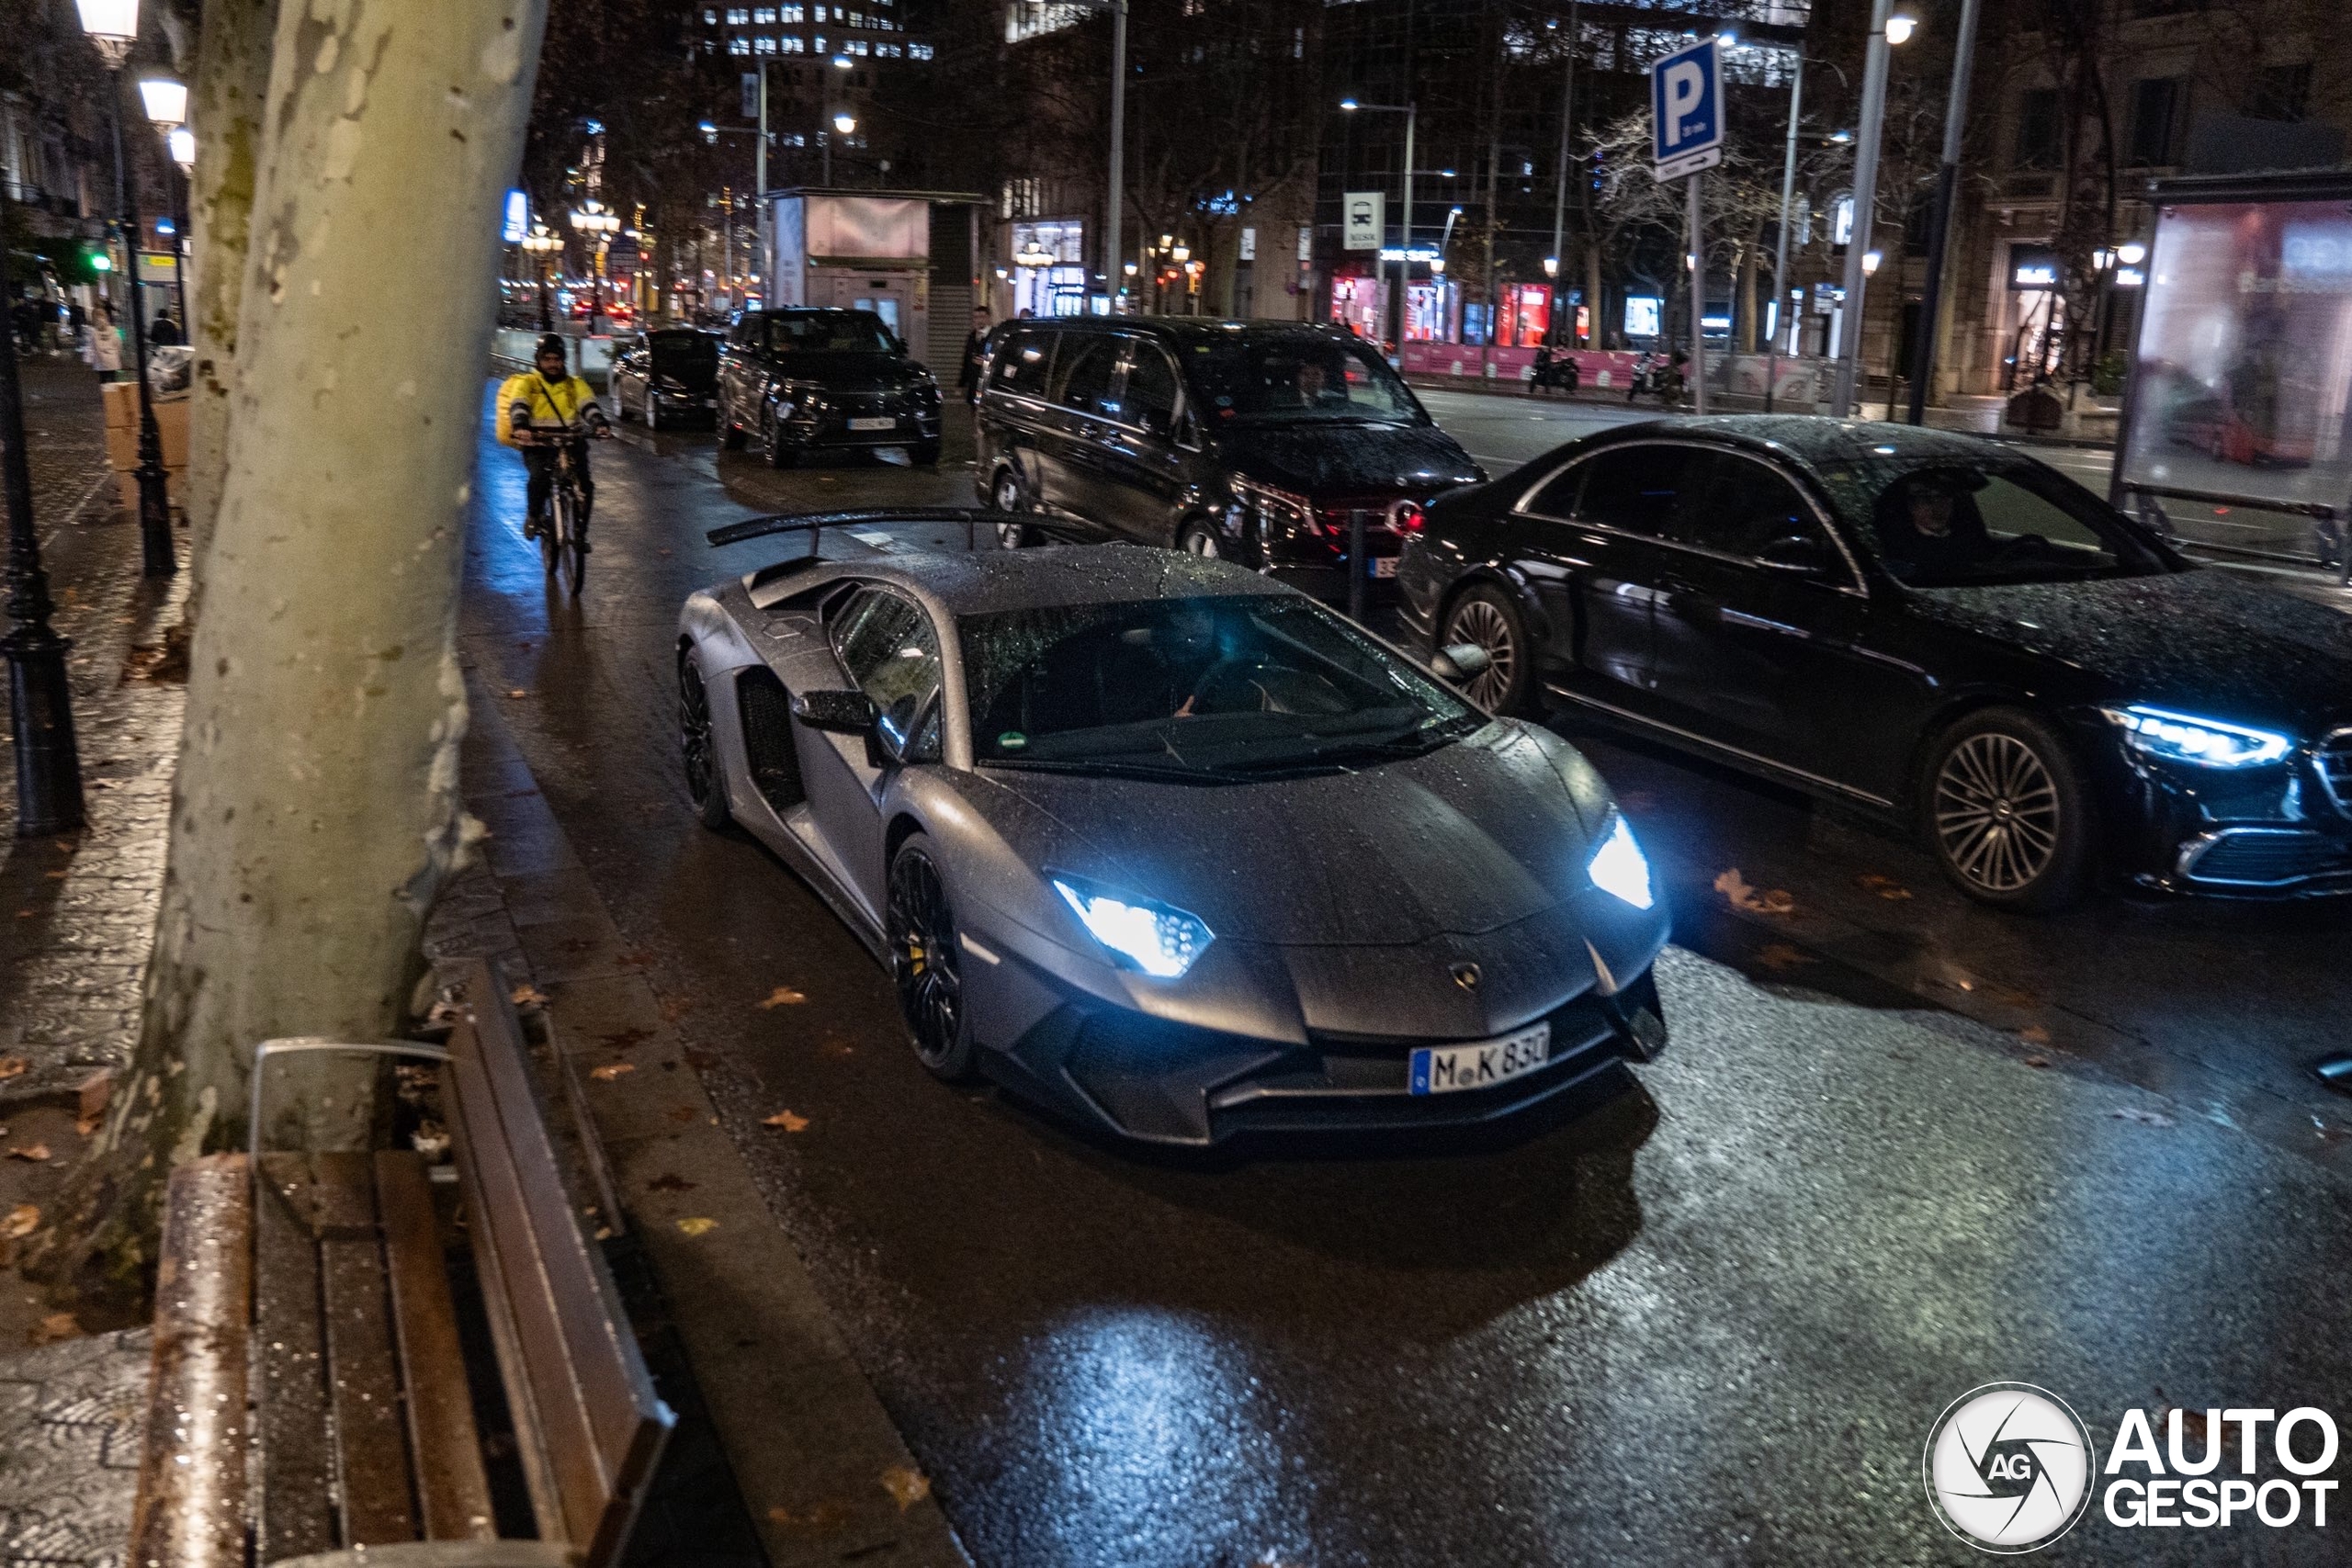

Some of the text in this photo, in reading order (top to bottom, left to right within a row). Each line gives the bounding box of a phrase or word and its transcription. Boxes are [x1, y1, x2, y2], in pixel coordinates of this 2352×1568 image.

[1664, 61, 1705, 147] P
[1434, 1054, 1456, 1087] M
[1478, 1048, 1498, 1082] K
